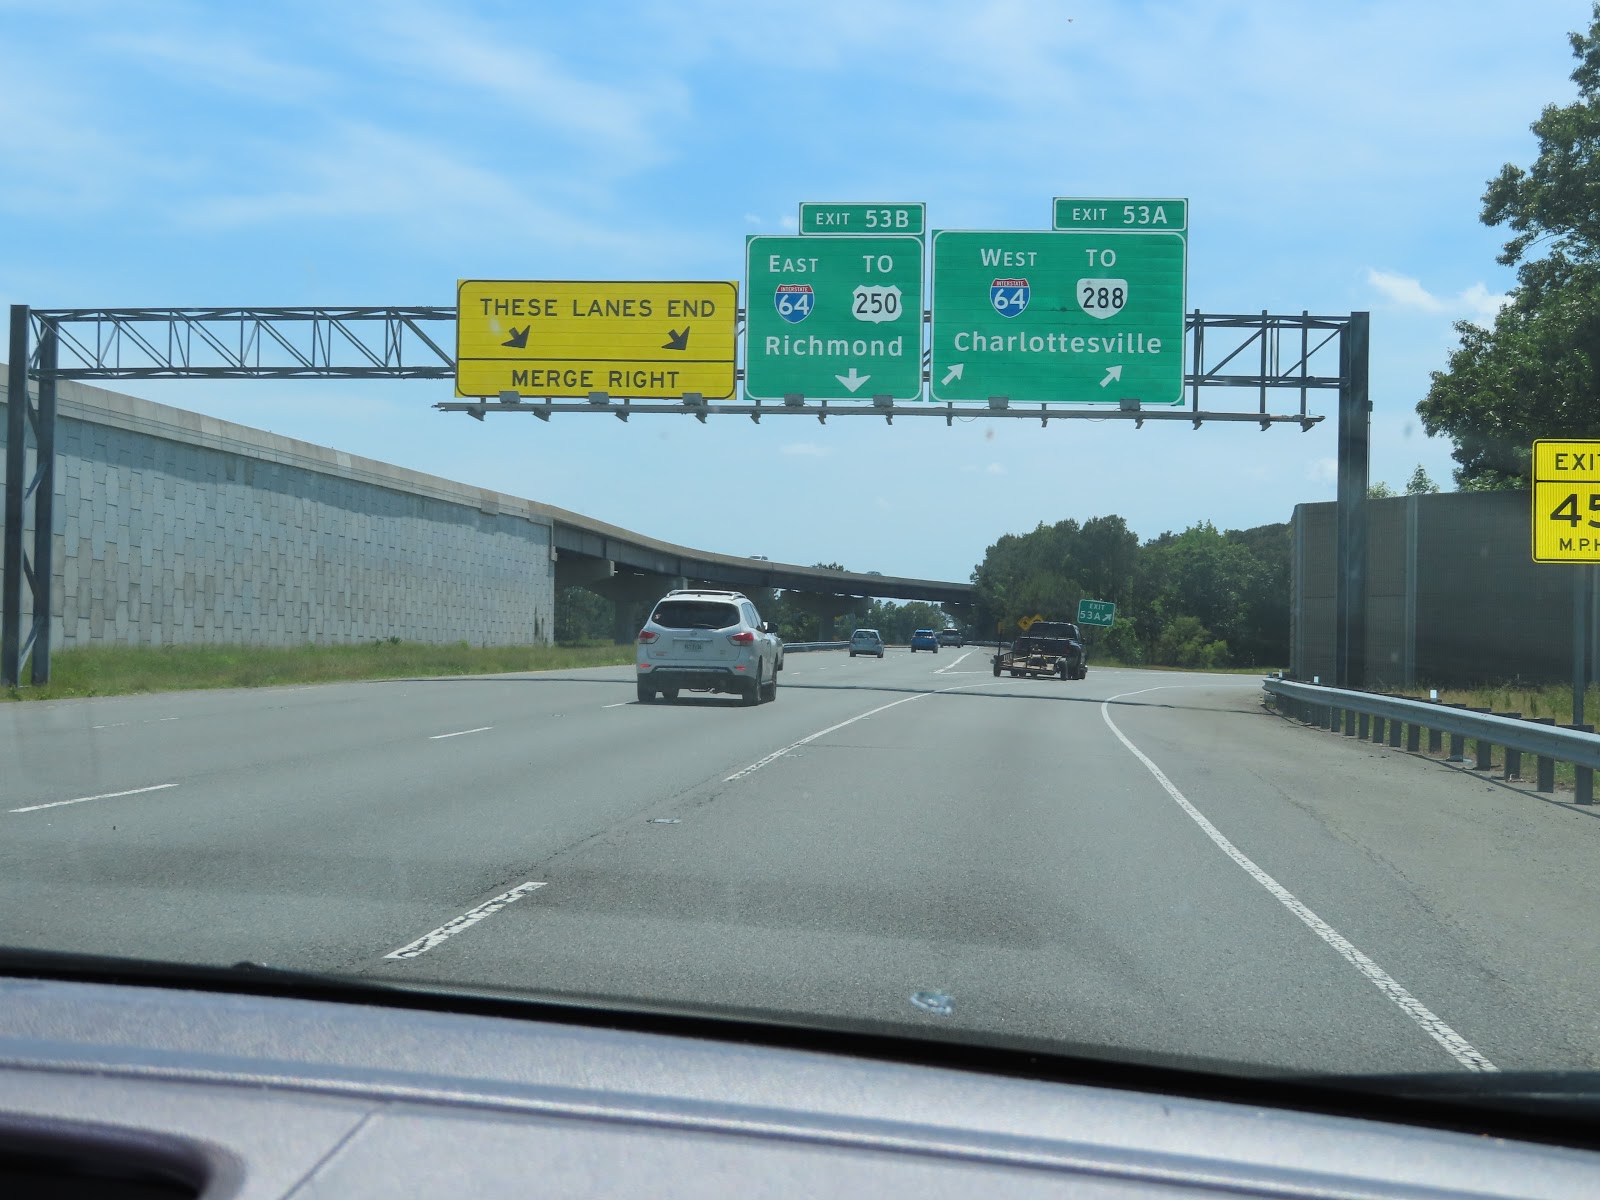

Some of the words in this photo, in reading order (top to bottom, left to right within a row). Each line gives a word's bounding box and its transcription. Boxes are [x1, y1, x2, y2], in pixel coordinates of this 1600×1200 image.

[816, 212, 850, 225] EXIT
[865, 209, 909, 228] 53B
[1072, 208, 1108, 221] EXIT
[1122, 205, 1168, 224] 53A
[769, 254, 819, 273] EAST
[863, 255, 893, 273] TO
[980, 248, 1038, 267] WEST
[1086, 249, 1116, 267] TO
[480, 297, 558, 317] THESE
[573, 299, 653, 318] LANES
[667, 300, 716, 318] END
[778, 294, 810, 316] 64
[856, 292, 897, 314] 250
[993, 288, 1026, 310] 64
[1082, 287, 1124, 309] 288
[765, 335, 903, 357] Richmond
[954, 331, 1162, 354] Charlottesville
[512, 369, 594, 388] MERGE
[608, 370, 680, 389] RIGHT
[1555, 453, 1600, 471] EXI
[1080, 611, 1101, 620] 53A
